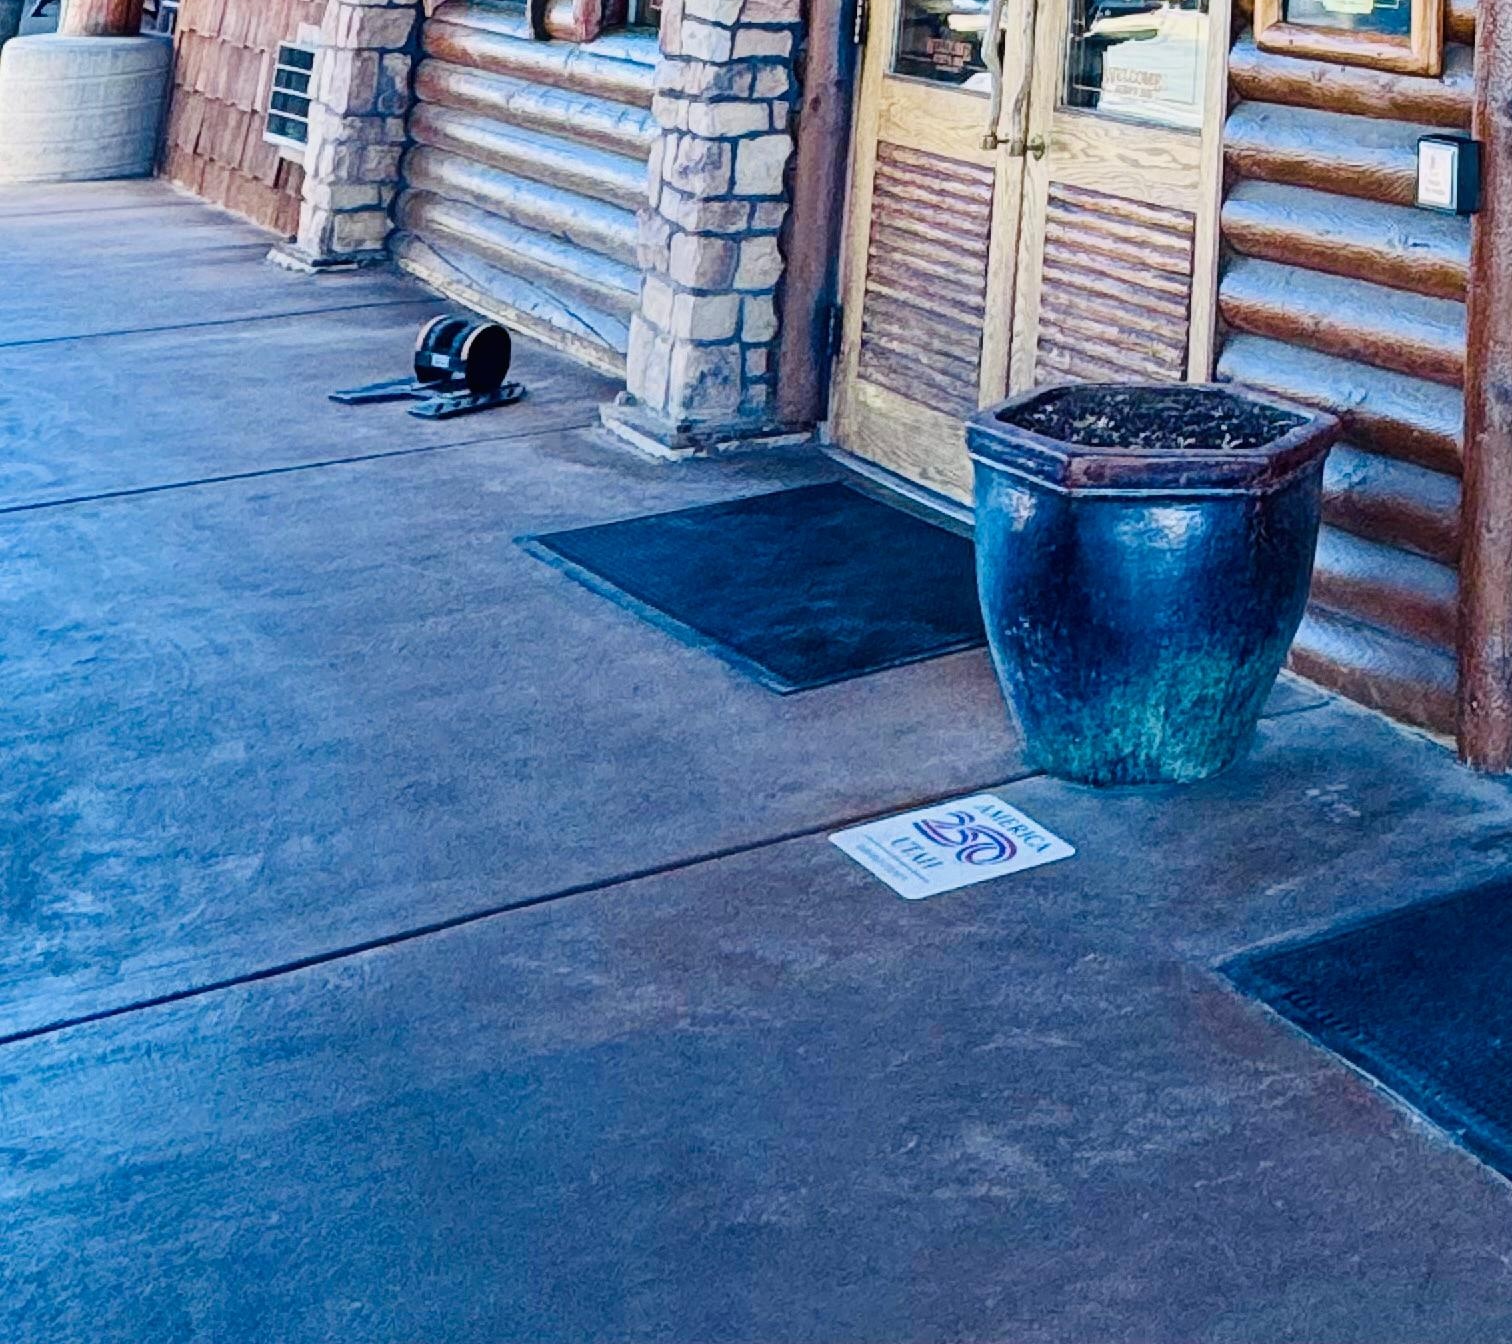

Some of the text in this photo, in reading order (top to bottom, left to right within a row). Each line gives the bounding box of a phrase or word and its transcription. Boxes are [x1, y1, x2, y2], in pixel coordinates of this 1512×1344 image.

[889, 835, 945, 870] UTAH
[911, 810, 1018, 866] 250
[974, 802, 1052, 854] AMERICA
